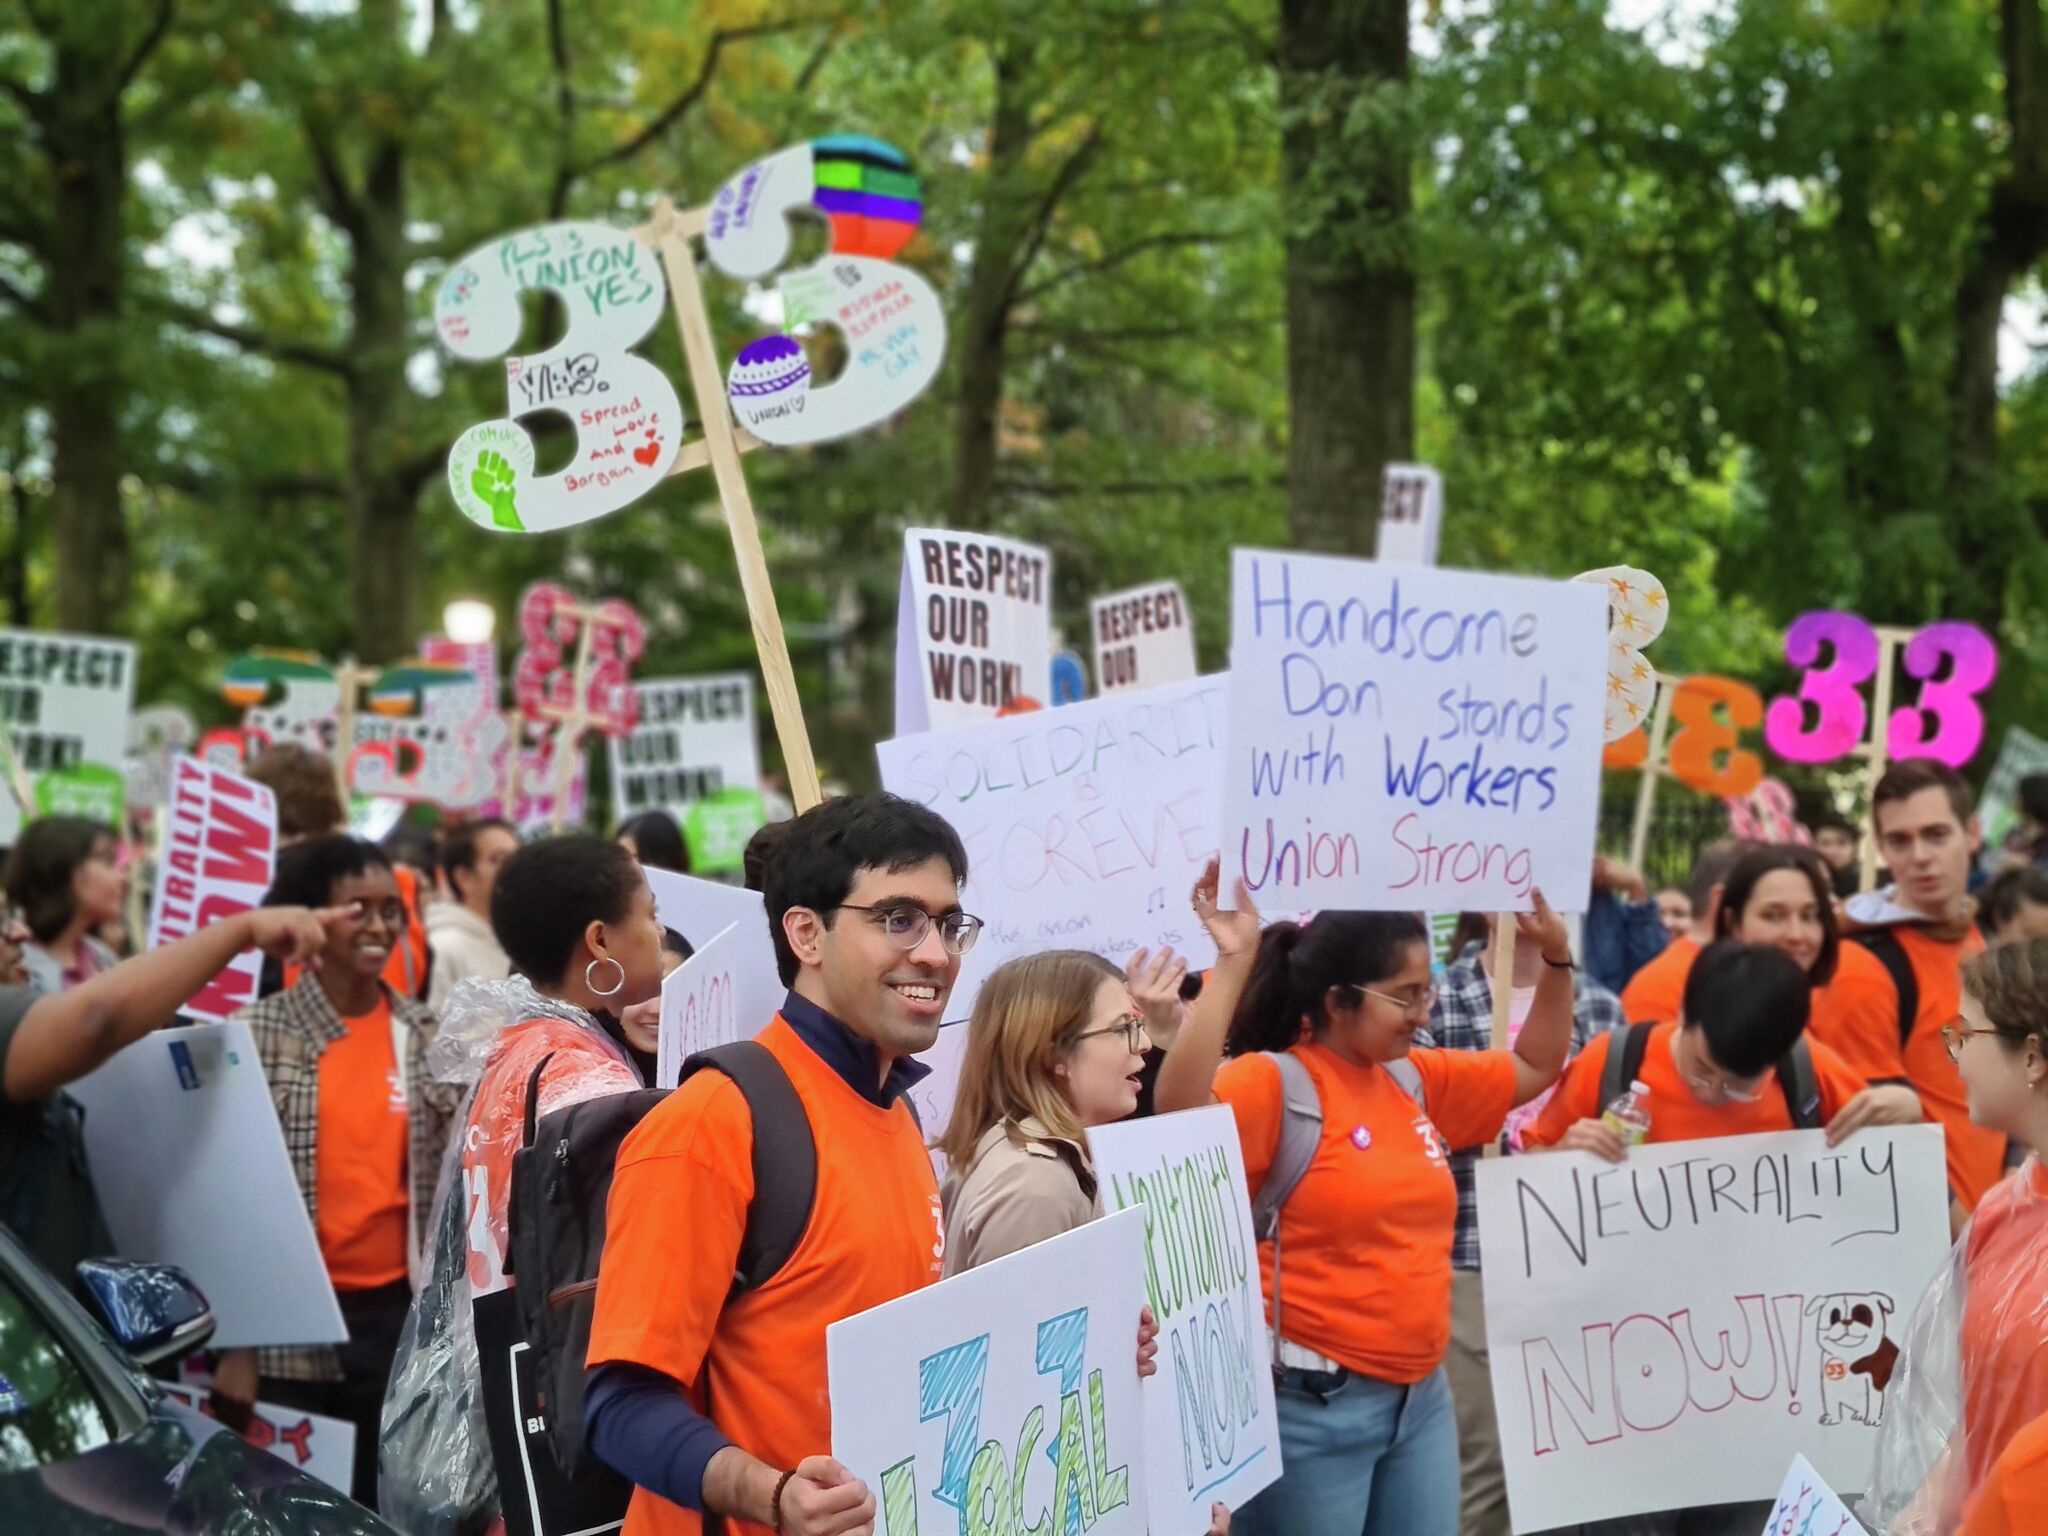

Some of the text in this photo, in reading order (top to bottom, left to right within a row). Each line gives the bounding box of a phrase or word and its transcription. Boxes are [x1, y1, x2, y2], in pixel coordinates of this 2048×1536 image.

[516, 241, 636, 288] UNION
[584, 269, 653, 315] YES
[580, 396, 642, 426] Spread
[612, 412, 660, 438] Love
[747, 401, 791, 425] UNION
[564, 465, 635, 493] Bargain
[919, 538, 1043, 606] RESPECT
[928, 593, 990, 649] OUR
[1098, 589, 1183, 643] RESPECT
[1252, 558, 1539, 662] Handsome
[928, 650, 1022, 708] WORK!
[1102, 644, 1138, 689] OUR
[1281, 652, 1574, 751] Dan stands
[622, 729, 681, 768] OUR
[904, 687, 1222, 807] SOLIDARIT
[1384, 733, 1557, 813] Workers
[962, 788, 1218, 905] FOREVE
[1241, 811, 1533, 899] Union Strong
[988, 914, 1094, 945] the union
[1157, 929, 1184, 947] us
[1516, 1141, 1899, 1279] NEUTRALITY
[1170, 1282, 1259, 1493] NOW
[1521, 1293, 1805, 1457] NOW!
